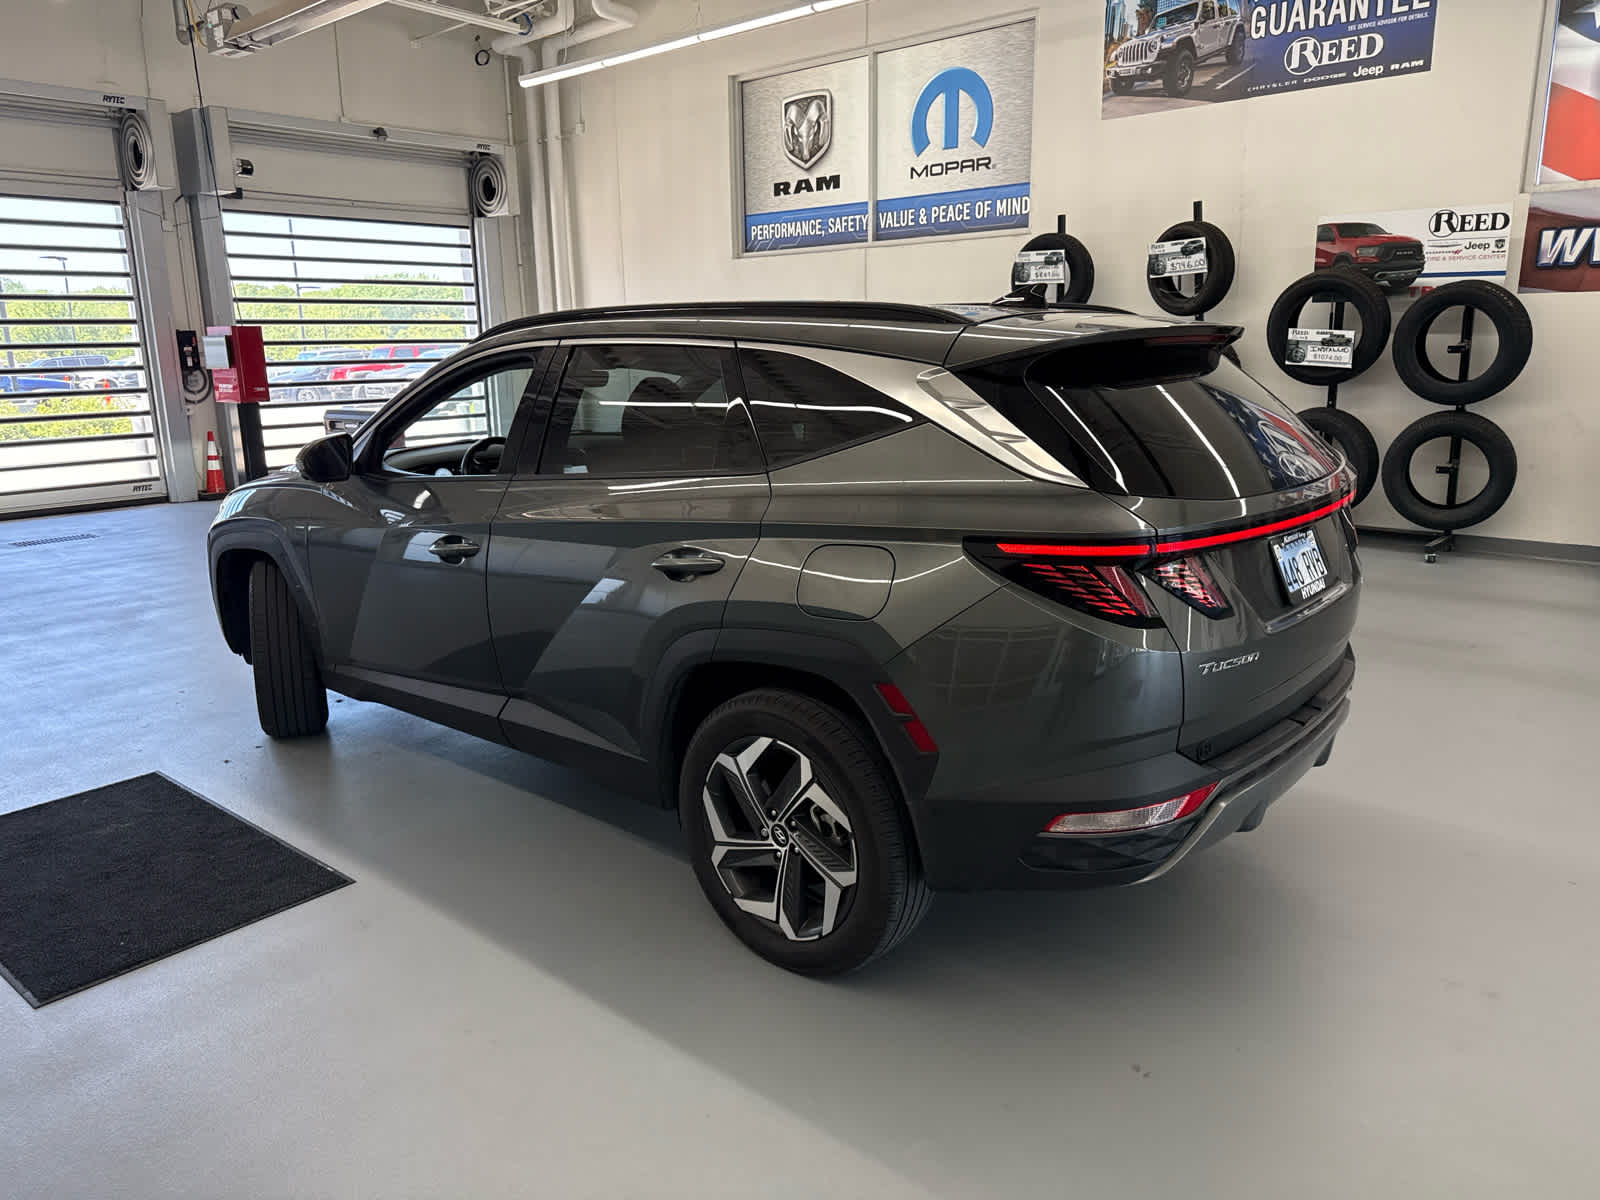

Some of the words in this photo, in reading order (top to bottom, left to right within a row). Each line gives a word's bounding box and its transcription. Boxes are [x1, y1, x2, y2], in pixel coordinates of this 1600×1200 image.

[1251, 0, 1430, 39] GUARAN
[1357, 21, 1376, 30] SERVICE
[1285, 33, 1384, 75] REED
[1248, 80, 1298, 92] CHRYSLER
[1303, 72, 1347, 83] DODGE
[1352, 65, 1384, 77] Jeep
[1390, 59, 1424, 70] RAM
[910, 156, 992, 179] MOPAR
[773, 174, 841, 197] RAM
[879, 210, 915, 229] VALUE
[918, 208, 927, 223] &
[931, 203, 971, 222] PEACE
[975, 200, 992, 218] OF
[996, 196, 1030, 216] MIND
[1429, 210, 1510, 237] REED
[751, 220, 825, 241] PERFORMANCE,
[828, 214, 868, 232] SAFETY
[1464, 241, 1490, 251] Jeep
[1282, 556, 1305, 590] 448
